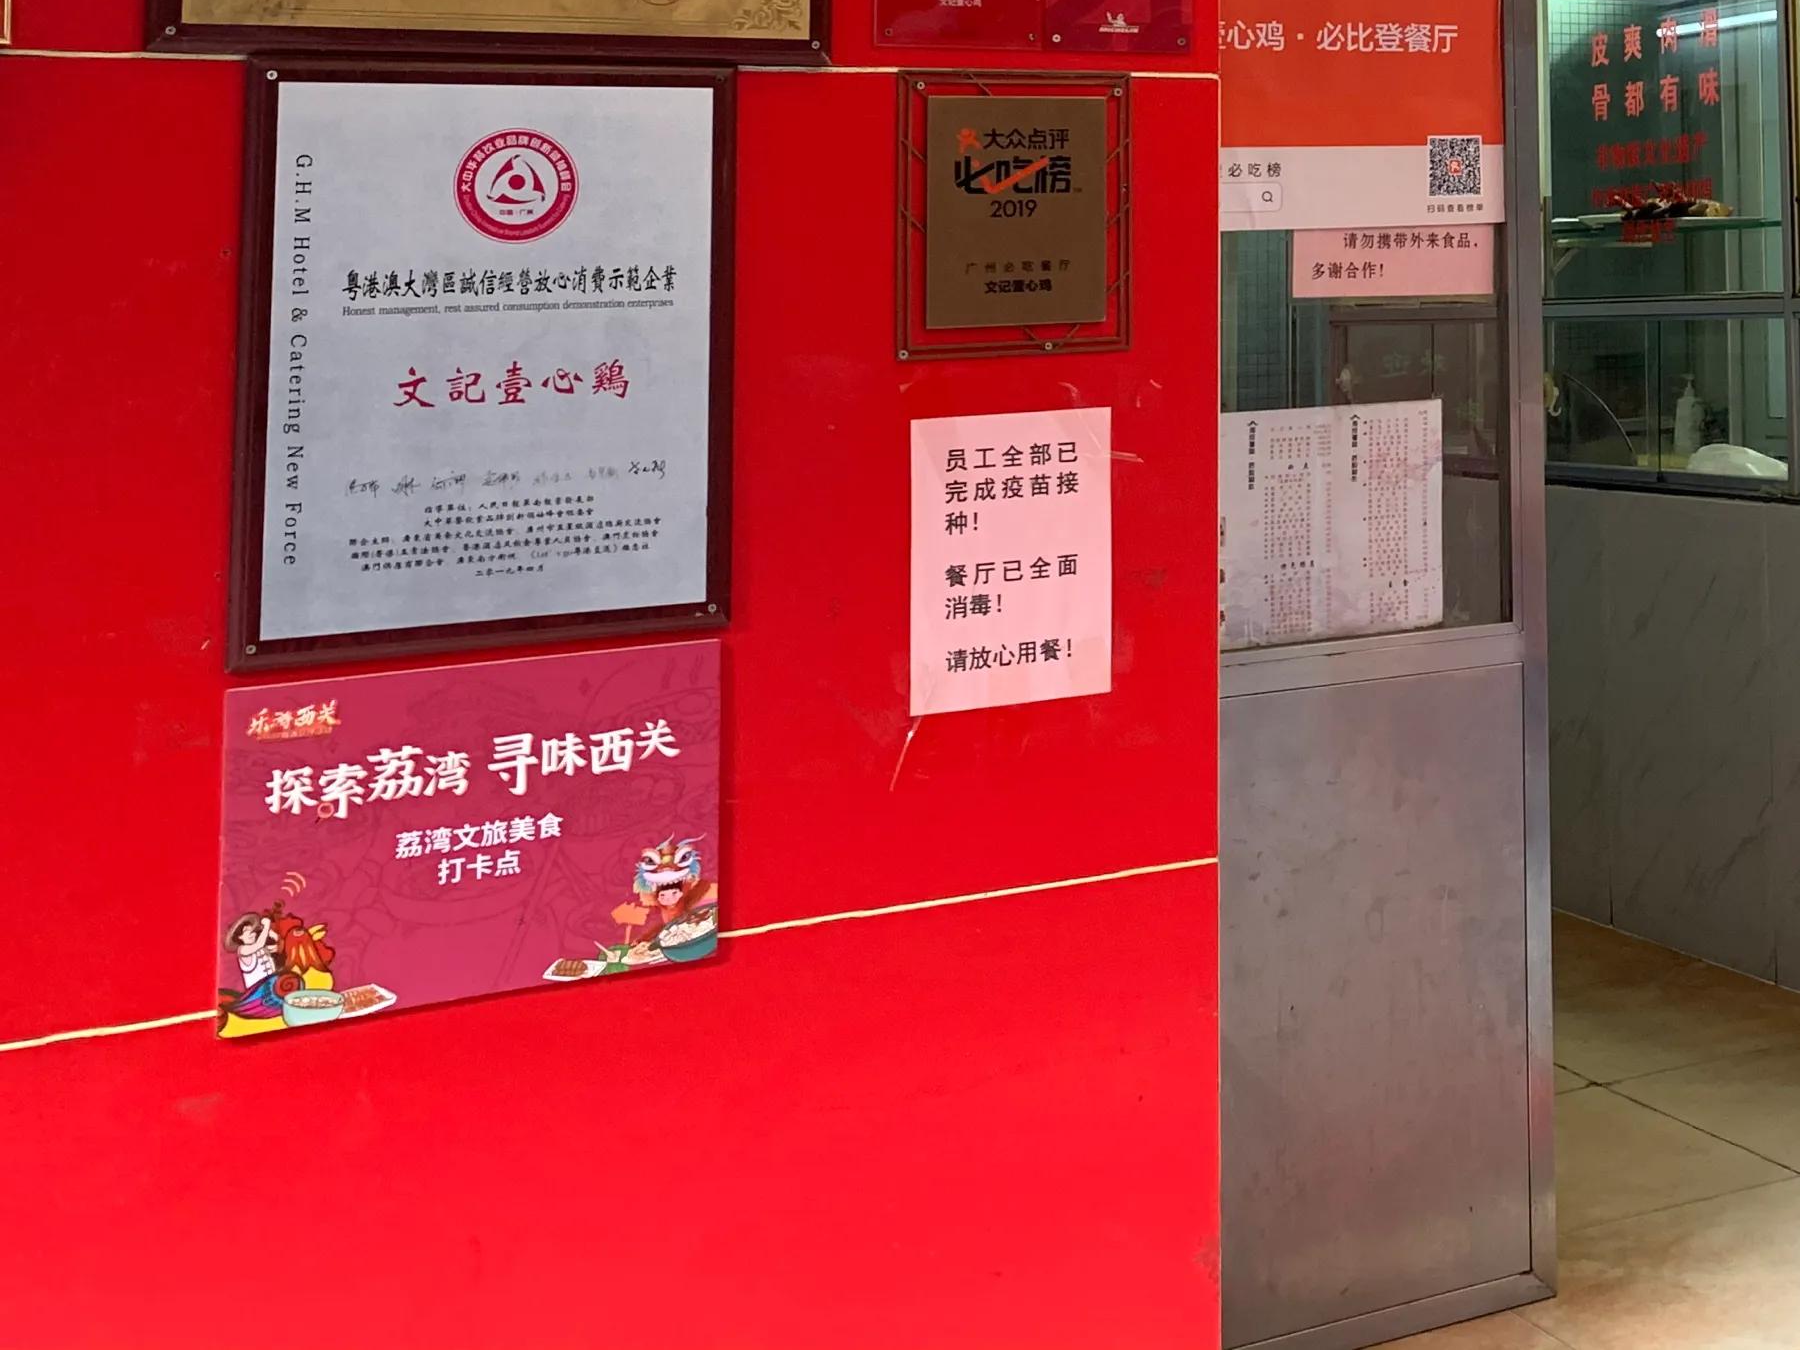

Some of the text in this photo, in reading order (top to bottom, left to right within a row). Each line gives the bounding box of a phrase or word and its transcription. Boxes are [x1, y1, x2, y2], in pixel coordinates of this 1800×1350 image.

[1589, 7, 1721, 69] 皮爽肉滑
[1590, 67, 1722, 123] 骨都有味
[983, 127, 1070, 150] 大众点评
[954, 154, 1072, 195] 必吃榜
[989, 199, 1038, 218] 2019
[292, 235, 311, 297] Hotel
[1311, 261, 1386, 281] 多谢合作！
[289, 307, 308, 323] &
[342, 305, 375, 318] Honest
[444, 304, 462, 314] rest
[463, 302, 500, 313] assured
[502, 301, 561, 314] consumption
[562, 300, 625, 311] demonstration
[627, 299, 675, 311] enterprises
[281, 334, 308, 436] Catering
[285, 445, 305, 482] New
[944, 440, 1079, 473] 员工全部已
[944, 472, 1080, 505] 完成疫苗接
[281, 502, 303, 567] Force
[944, 510, 980, 537] 种！
[944, 553, 1078, 589] 餐厅已全面
[944, 593, 1003, 621] 消毒！
[944, 638, 1075, 675] 请放心用餐！
[264, 718, 681, 820] 探索荔湾 寻味西关
[394, 812, 565, 860] 荔湾文旅美食
[437, 850, 523, 886] 打卡点
